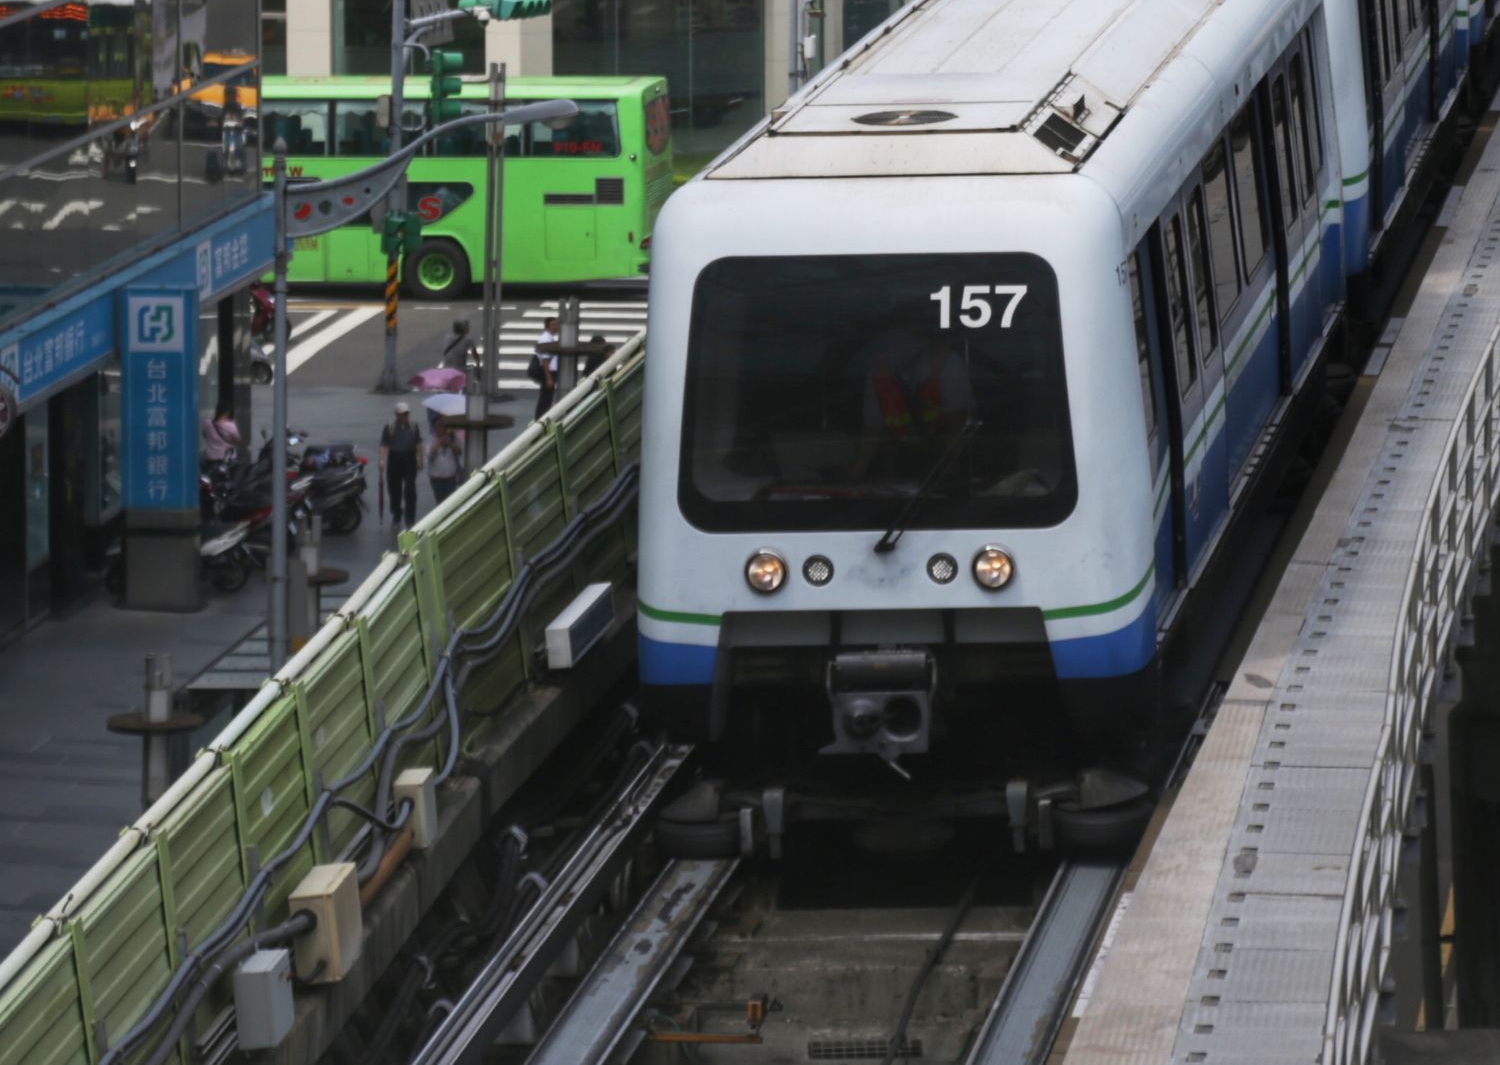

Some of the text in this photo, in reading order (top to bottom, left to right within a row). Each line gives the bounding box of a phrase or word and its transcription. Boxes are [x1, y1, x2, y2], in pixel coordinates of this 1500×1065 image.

[929, 285, 1028, 329] 157
[146, 359, 168, 501] 台北富邦銀行
